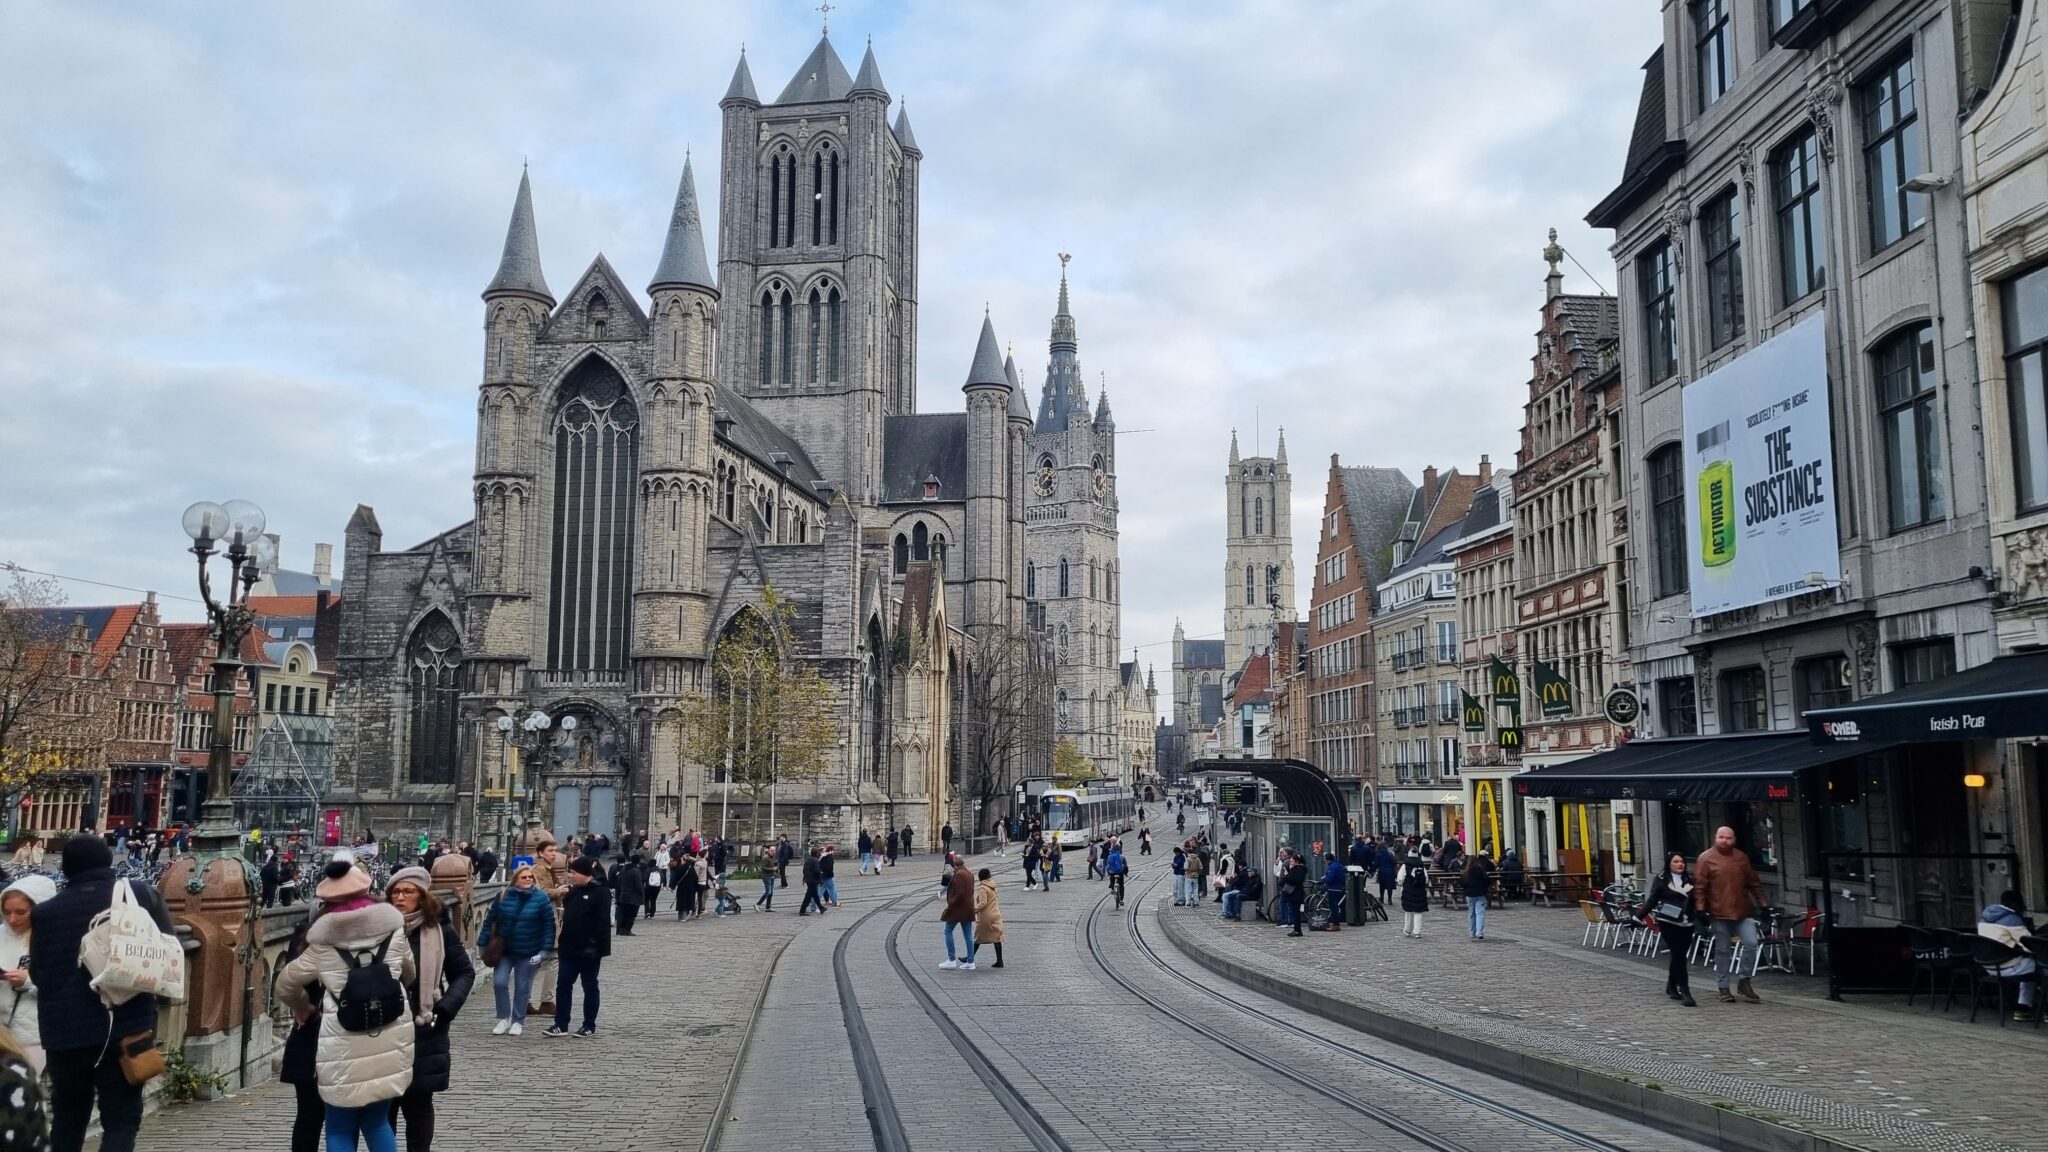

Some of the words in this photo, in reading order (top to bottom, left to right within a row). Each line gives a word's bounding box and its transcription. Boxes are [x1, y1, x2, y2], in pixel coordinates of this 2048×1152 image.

[1764, 425, 1793, 475] THE
[1710, 479, 1725, 555] ACTIVATOR
[1744, 459, 1825, 527] SUBSTANCE
[1210, 747, 1242, 755] Korenmarkt
